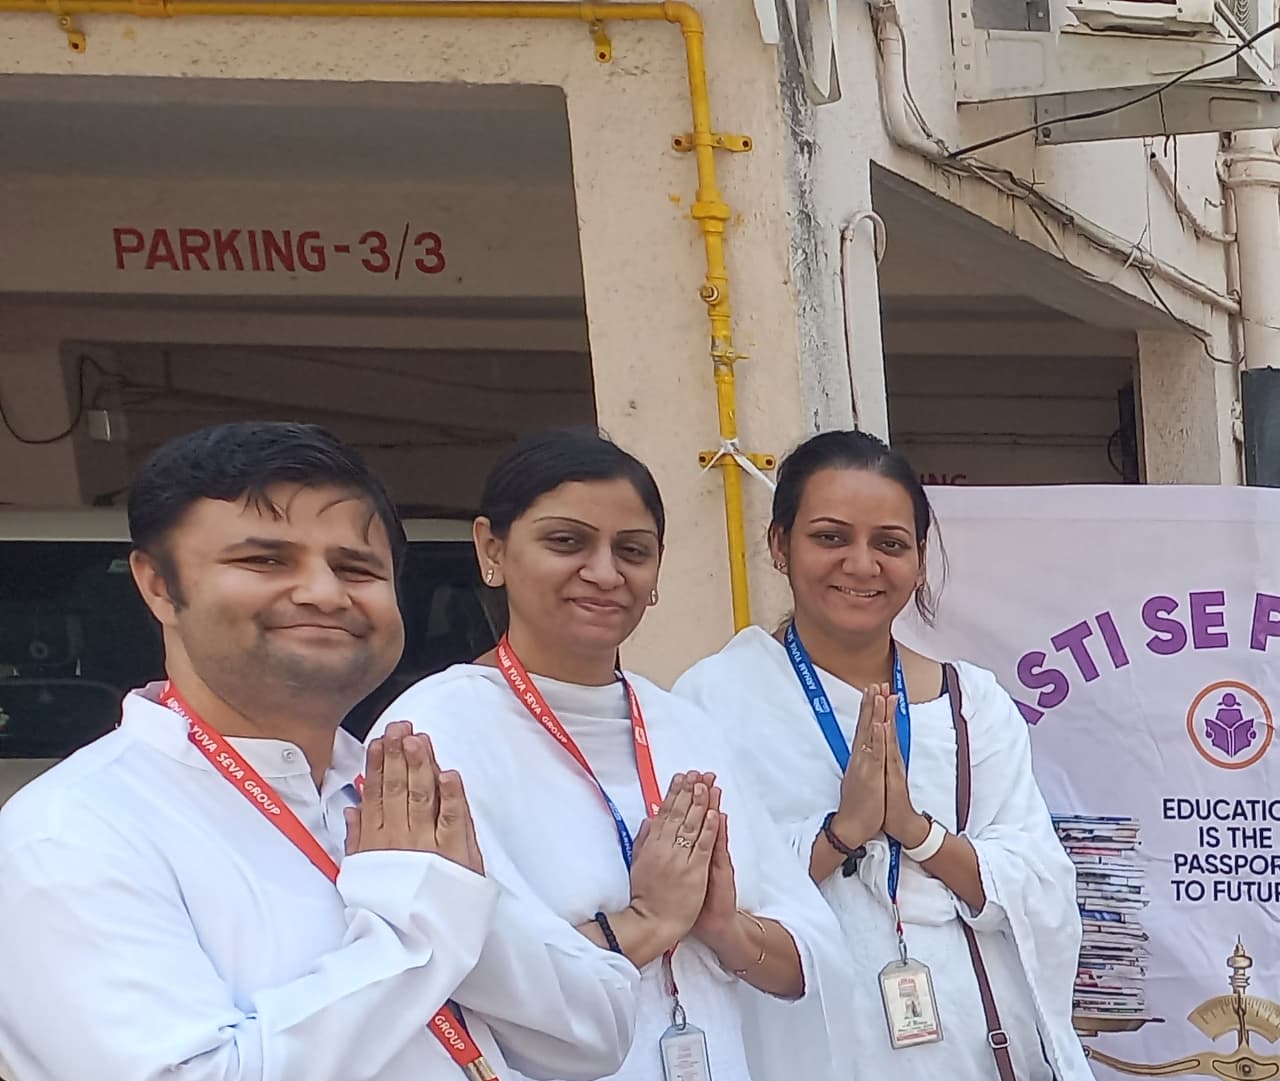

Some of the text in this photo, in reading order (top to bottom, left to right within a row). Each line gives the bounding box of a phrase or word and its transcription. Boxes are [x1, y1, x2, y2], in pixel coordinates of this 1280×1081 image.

[1013, 611, 1129, 726] STI
[1141, 590, 1228, 655] SE
[507, 666, 526, 693] YUVA
[523, 691, 543, 716] SEVA
[540, 715, 568, 744] GROUP
[190, 724, 218, 753] YUVA
[215, 751, 245, 780] SEVA
[243, 780, 281, 815] GROUP
[1199, 826, 1273, 849] IS THE
[1171, 880, 1206, 902] TO
[434, 1015, 466, 1052] GROUP
